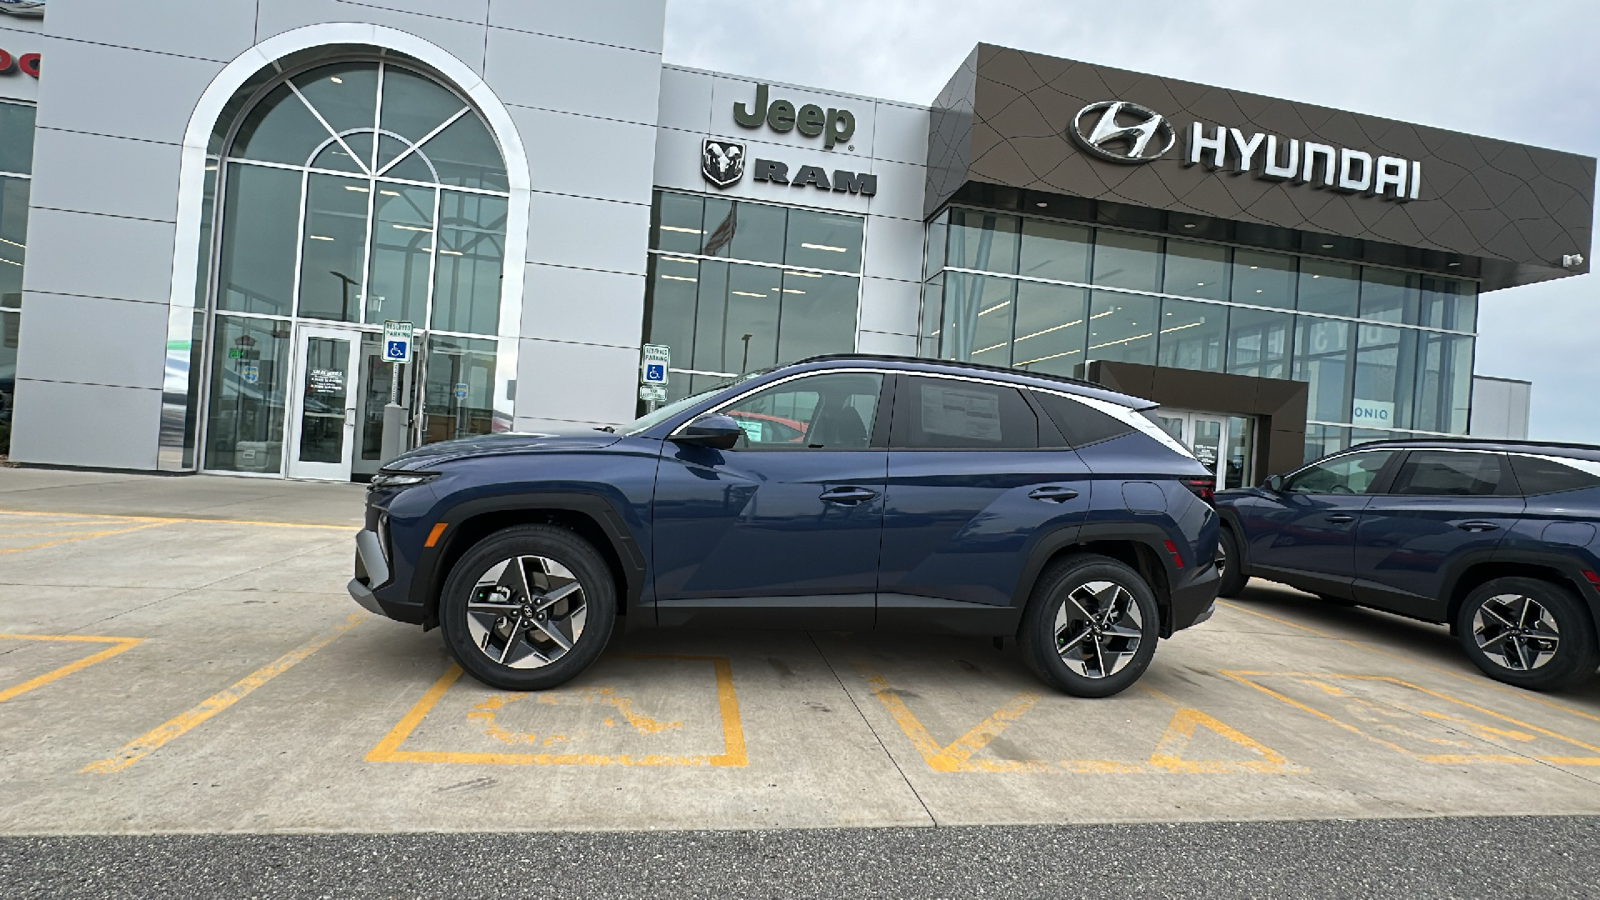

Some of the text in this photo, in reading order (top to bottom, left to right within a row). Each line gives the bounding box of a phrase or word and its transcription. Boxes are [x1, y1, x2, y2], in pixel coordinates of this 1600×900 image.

[733, 83, 856, 150] Jeep
[753, 158, 878, 197] RAM
[1187, 121, 1421, 199] HYUNDAI
